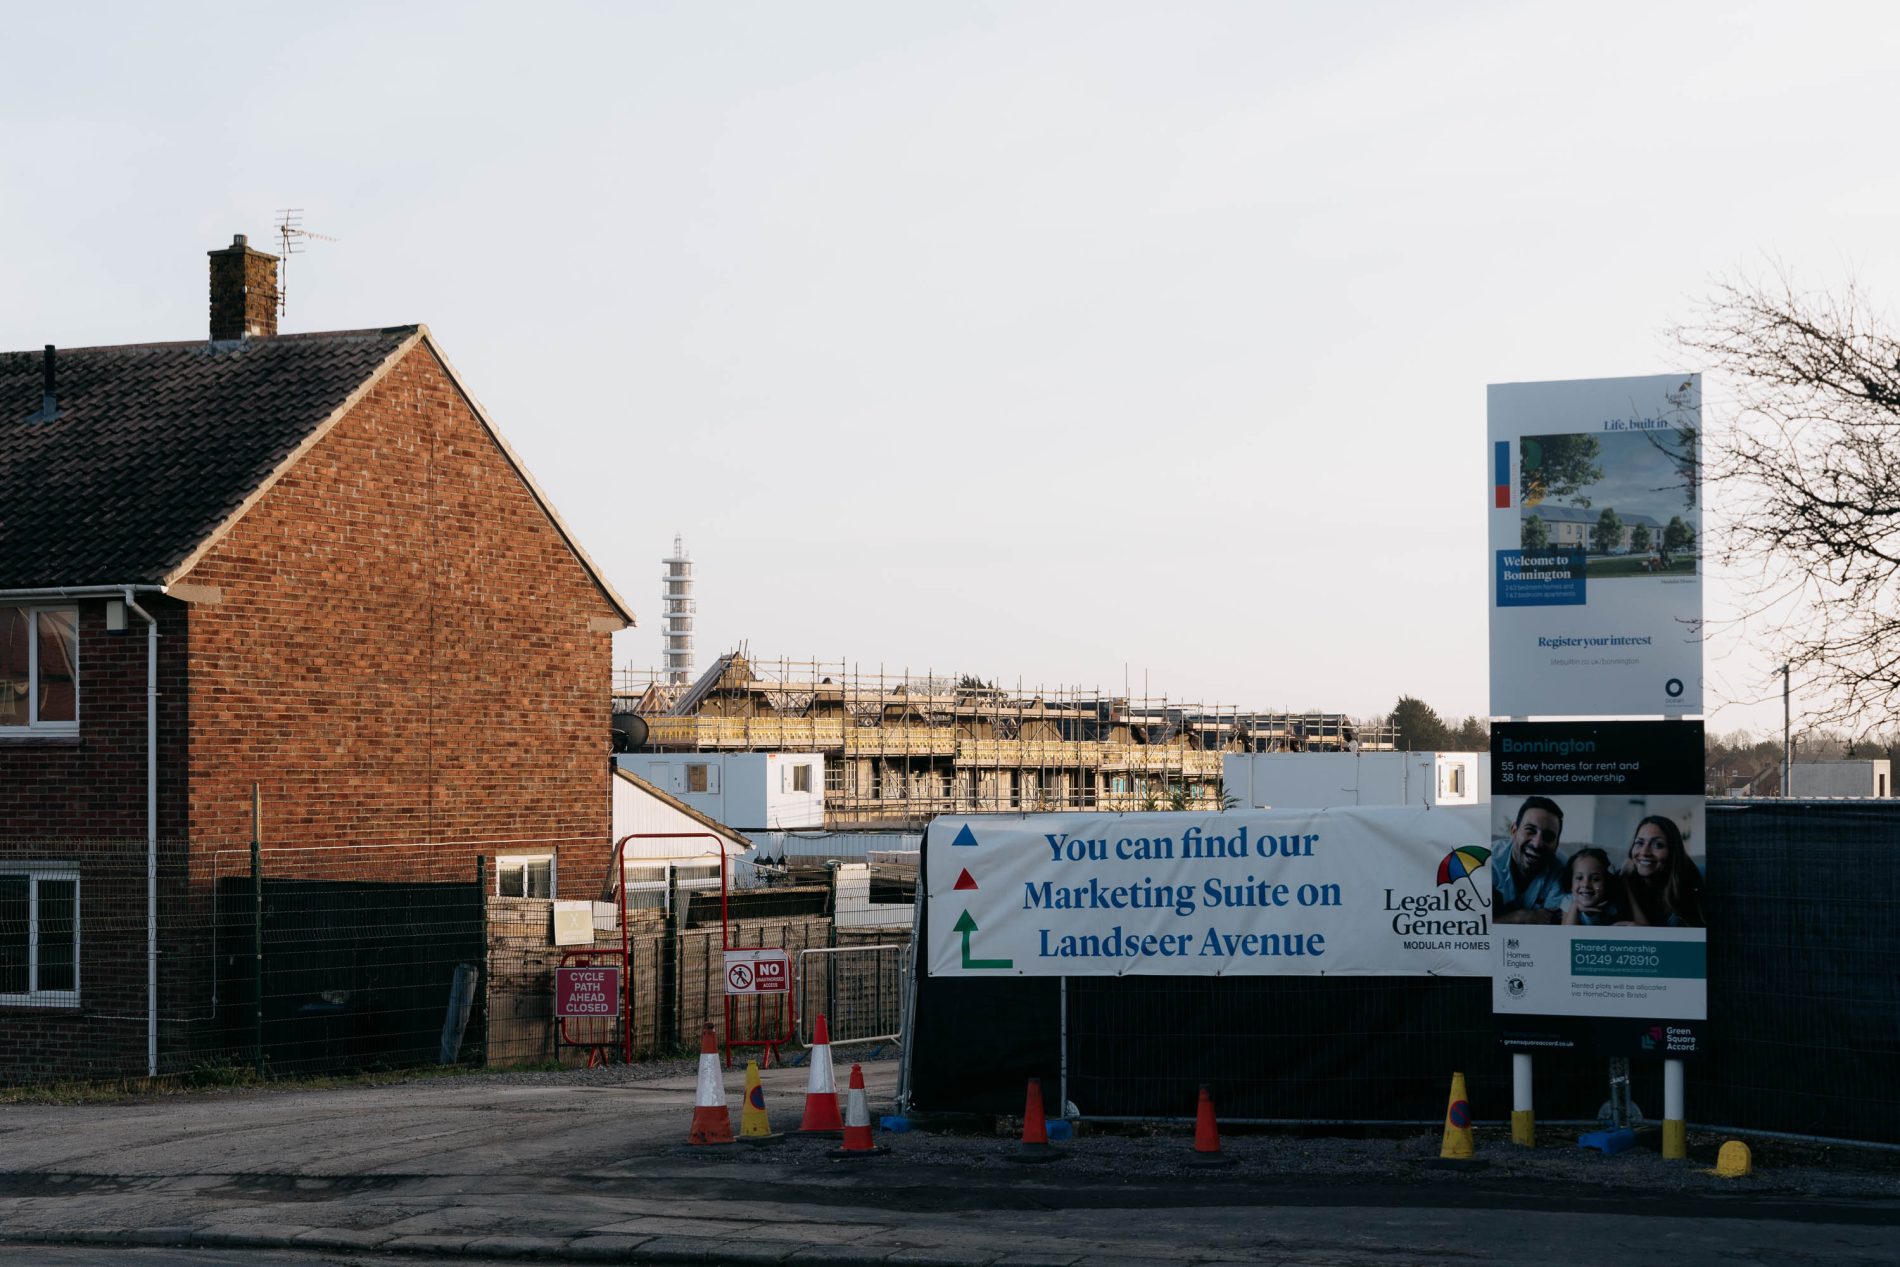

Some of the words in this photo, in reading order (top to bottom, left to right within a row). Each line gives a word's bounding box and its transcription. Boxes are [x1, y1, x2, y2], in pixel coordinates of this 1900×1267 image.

[1604, 419, 1628, 431] Life,
[1629, 418, 1655, 429] built
[1657, 417, 1668, 428] in
[1503, 555, 1555, 566] Welcome
[1557, 556, 1569, 565] to
[1503, 569, 1571, 582] Bonnington
[1538, 636, 1583, 649] Register
[1583, 637, 1610, 649] your
[1610, 635, 1652, 646] interest
[1502, 738, 1596, 755] Bonnington
[1501, 761, 1514, 771] 55
[1541, 761, 1576, 770] homes
[1579, 761, 1593, 770] for
[1596, 761, 1617, 770] rent
[1619, 761, 1640, 770] and
[1501, 773, 1514, 782] 38
[1516, 773, 1531, 782] for
[1533, 773, 1569, 782] shared
[1571, 773, 1626, 783] ownership
[1045, 833, 1108, 861] You
[1115, 837, 1174, 860] can
[1181, 826, 1249, 859] find
[1256, 832, 1320, 857] our
[1022, 876, 1197, 917] Marketing
[1203, 875, 1290, 908] Suite
[1297, 882, 1342, 907] on
[1383, 888, 1451, 917] Legal
[1454, 888, 1476, 912] &
[1392, 912, 1491, 936] General
[1038, 926, 1193, 957] Landseer
[1198, 927, 1326, 957] Avenue
[1403, 941, 1452, 950] MODULAR
[1454, 941, 1491, 950] HOMES
[1575, 943, 1607, 952] Shared
[1609, 945, 1656, 954] ownership
[1506, 951, 1531, 959] Homes
[1575, 954, 1612, 965] 01249
[1616, 955, 1660, 966] 478910
[759, 963, 780, 976] NO
[1506, 960, 1534, 968] England
[570, 972, 605, 981] CYCLE
[574, 982, 600, 991] PATH
[569, 993, 605, 1002] AHEAD
[566, 1003, 609, 1013] CLOSED
[1666, 1026, 1691, 1035] Green
[1666, 1034, 1696, 1044] Square
[1666, 1042, 1696, 1051] Accord
